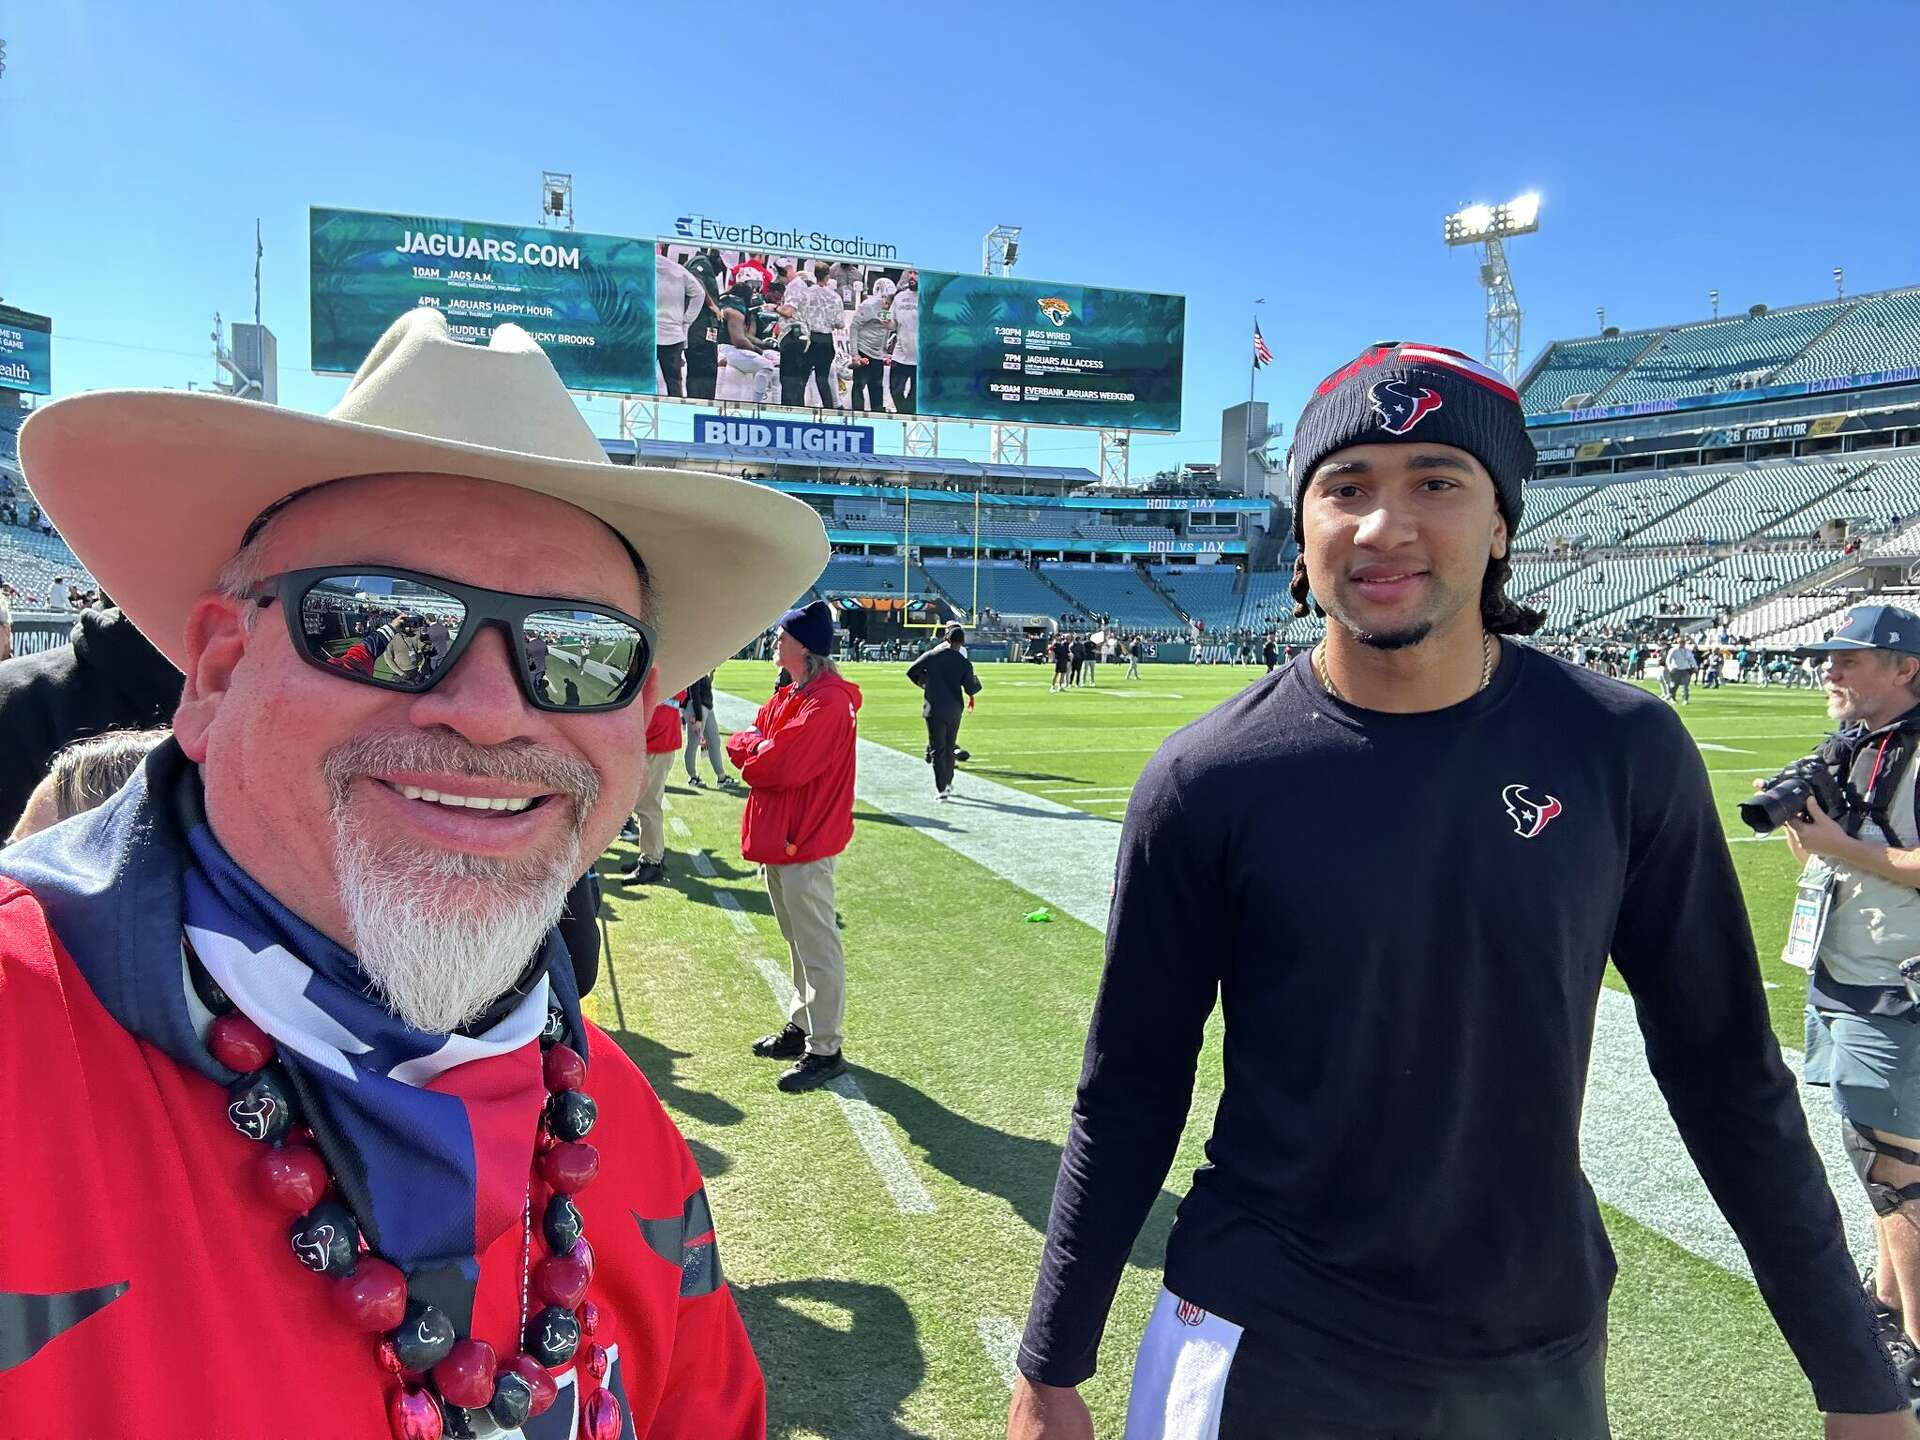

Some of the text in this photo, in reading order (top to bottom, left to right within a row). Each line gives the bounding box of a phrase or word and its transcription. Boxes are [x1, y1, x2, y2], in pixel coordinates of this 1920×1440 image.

[700, 219, 898, 260] EverBank Stadium
[396, 231, 580, 270] JAGUARS.COM
[413, 267, 494, 283] 10AM JAGS A.M.
[418, 296, 553, 318] 4PM JAGUARS HAPPY HOUR
[11, 331, 21, 340] TO
[448, 324, 487, 337] HUDDLE
[558, 333, 595, 346] BROOKS
[994, 327, 1021, 338] 7:30PM
[1025, 329, 1046, 340] JAGS
[1046, 331, 1071, 342] WIRED
[3, 338, 24, 350] GAME
[1004, 353, 1021, 363] 7PM
[1025, 355, 1060, 367] JAGUARS
[1060, 357, 1074, 367] ALL
[1075, 359, 1104, 369] ACCESS
[990, 383, 1135, 403] 10:30AM EVERBANK JAGUARS WEEKEND
[1805, 376, 1853, 394] TEXANS
[1568, 407, 1609, 422] TEXANS
[1630, 398, 1680, 415] JAGUARS
[704, 421, 865, 453] BUD LIGHT
[1746, 427, 1770, 441] FRED
[1773, 423, 1807, 438] TAYLOR
[1536, 447, 1575, 462] COUGHLIN
[1146, 499, 1170, 509] HOU
[1192, 499, 1216, 508] JAX
[1148, 541, 1174, 553] HOU
[1200, 541, 1225, 553] JAX
